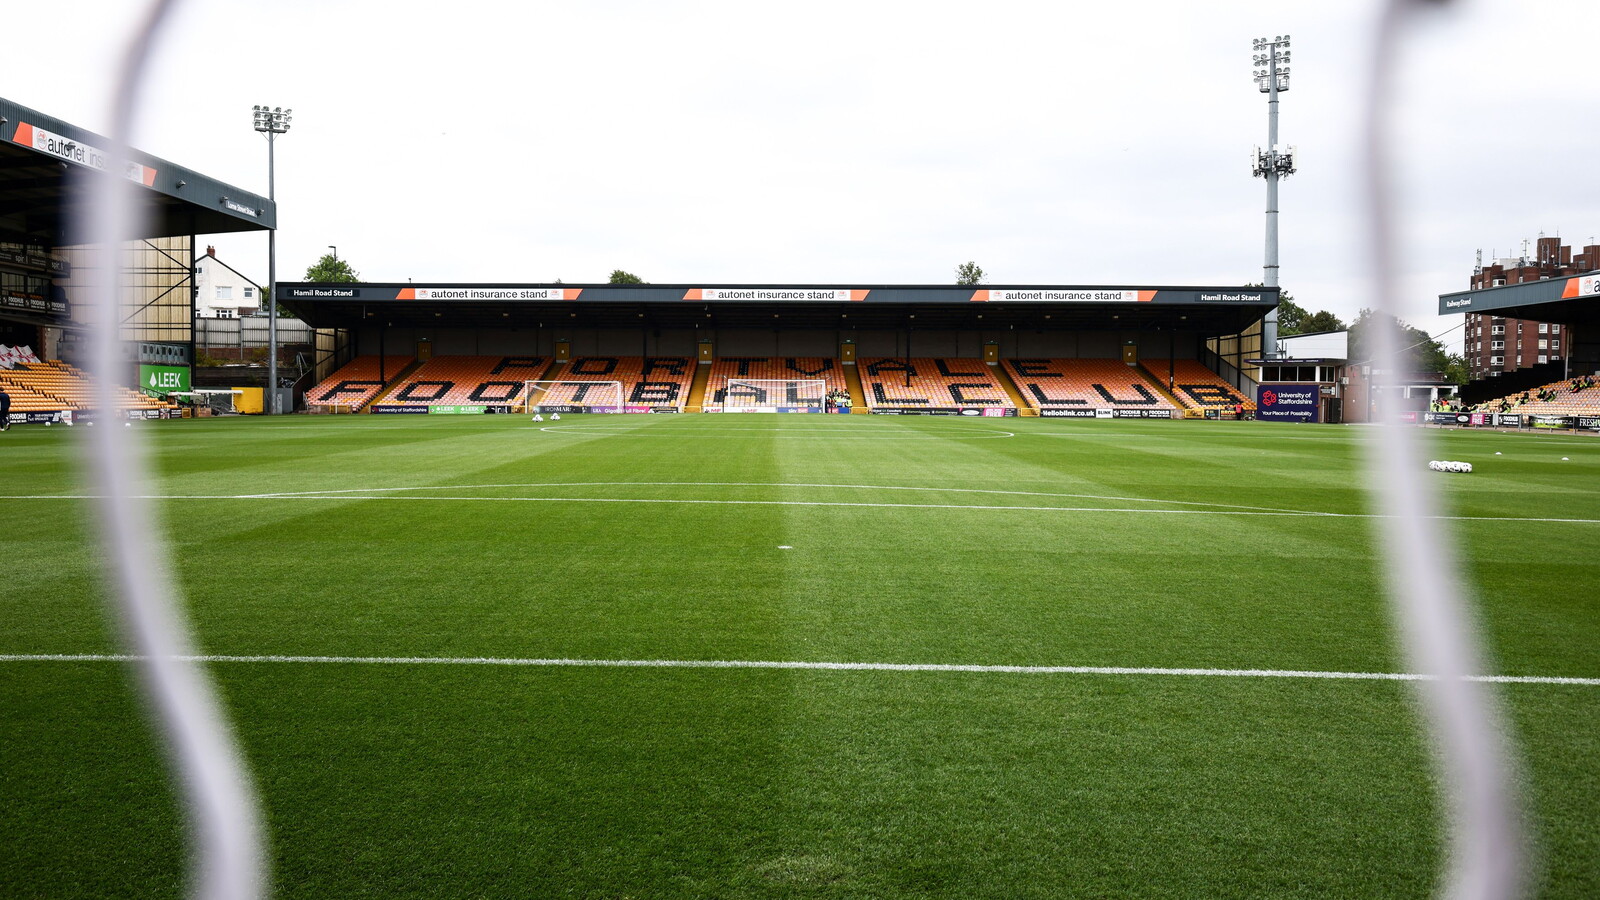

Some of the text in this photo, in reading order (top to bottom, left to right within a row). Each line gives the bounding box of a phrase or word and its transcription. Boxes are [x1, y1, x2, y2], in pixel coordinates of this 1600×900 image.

[47, 138, 86, 163] autonet
[293, 289, 353, 297] Hamil Road Stand
[431, 290, 548, 298] autonet insurance stand
[718, 291, 835, 299] autonet insurance stand
[1005, 291, 1122, 300] autonet insurance stand
[1446, 297, 1472, 308] Railway Stand
[490, 356, 1065, 377] PORT VALE
[158, 372, 181, 387] LEEK
[319, 380, 1246, 407] FOOTBALL CLUB
